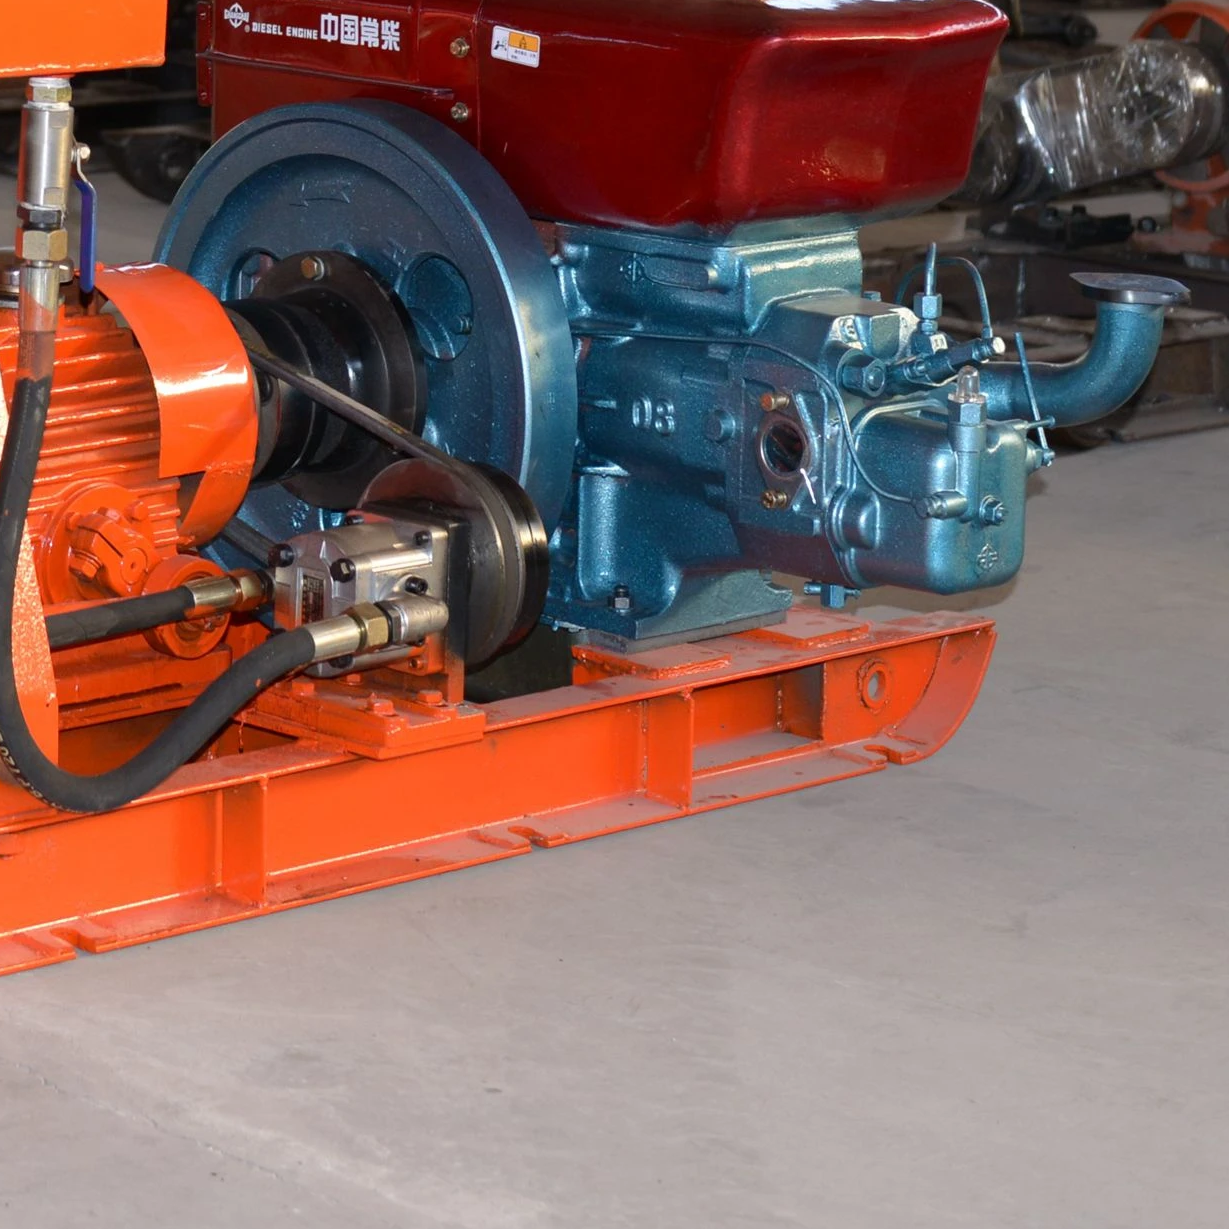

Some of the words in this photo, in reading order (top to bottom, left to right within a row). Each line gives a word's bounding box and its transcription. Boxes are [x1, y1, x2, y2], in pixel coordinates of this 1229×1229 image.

[251, 22, 283, 36] DIESEL
[285, 25, 319, 40] ENGINE
[320, 12, 400, 52] 中国常柴
